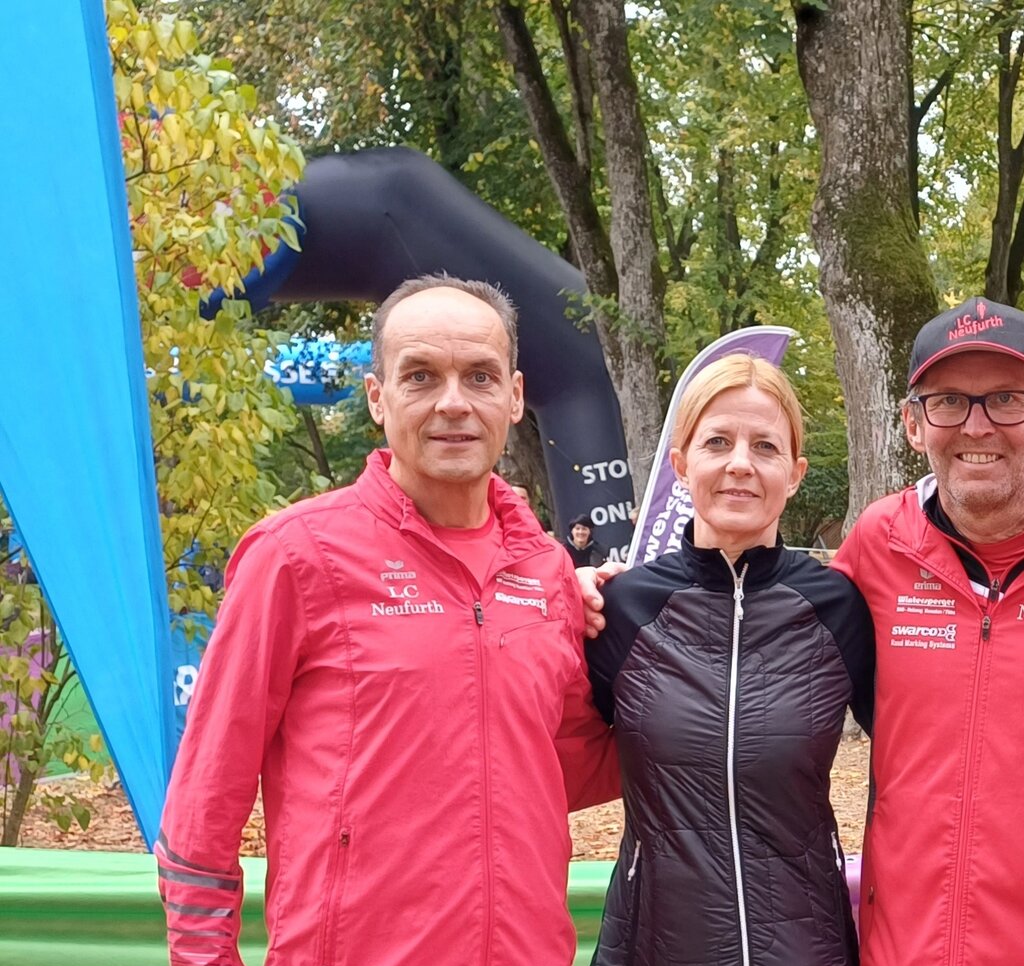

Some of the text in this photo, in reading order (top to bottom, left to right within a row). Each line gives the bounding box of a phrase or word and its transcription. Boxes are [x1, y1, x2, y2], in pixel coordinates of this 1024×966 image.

[948, 315, 1004, 341] Neufurth
[956, 314, 972, 329] LC
[387, 584, 420, 599] LC
[914, 581, 942, 591] erima
[370, 600, 445, 616] Neufurth
